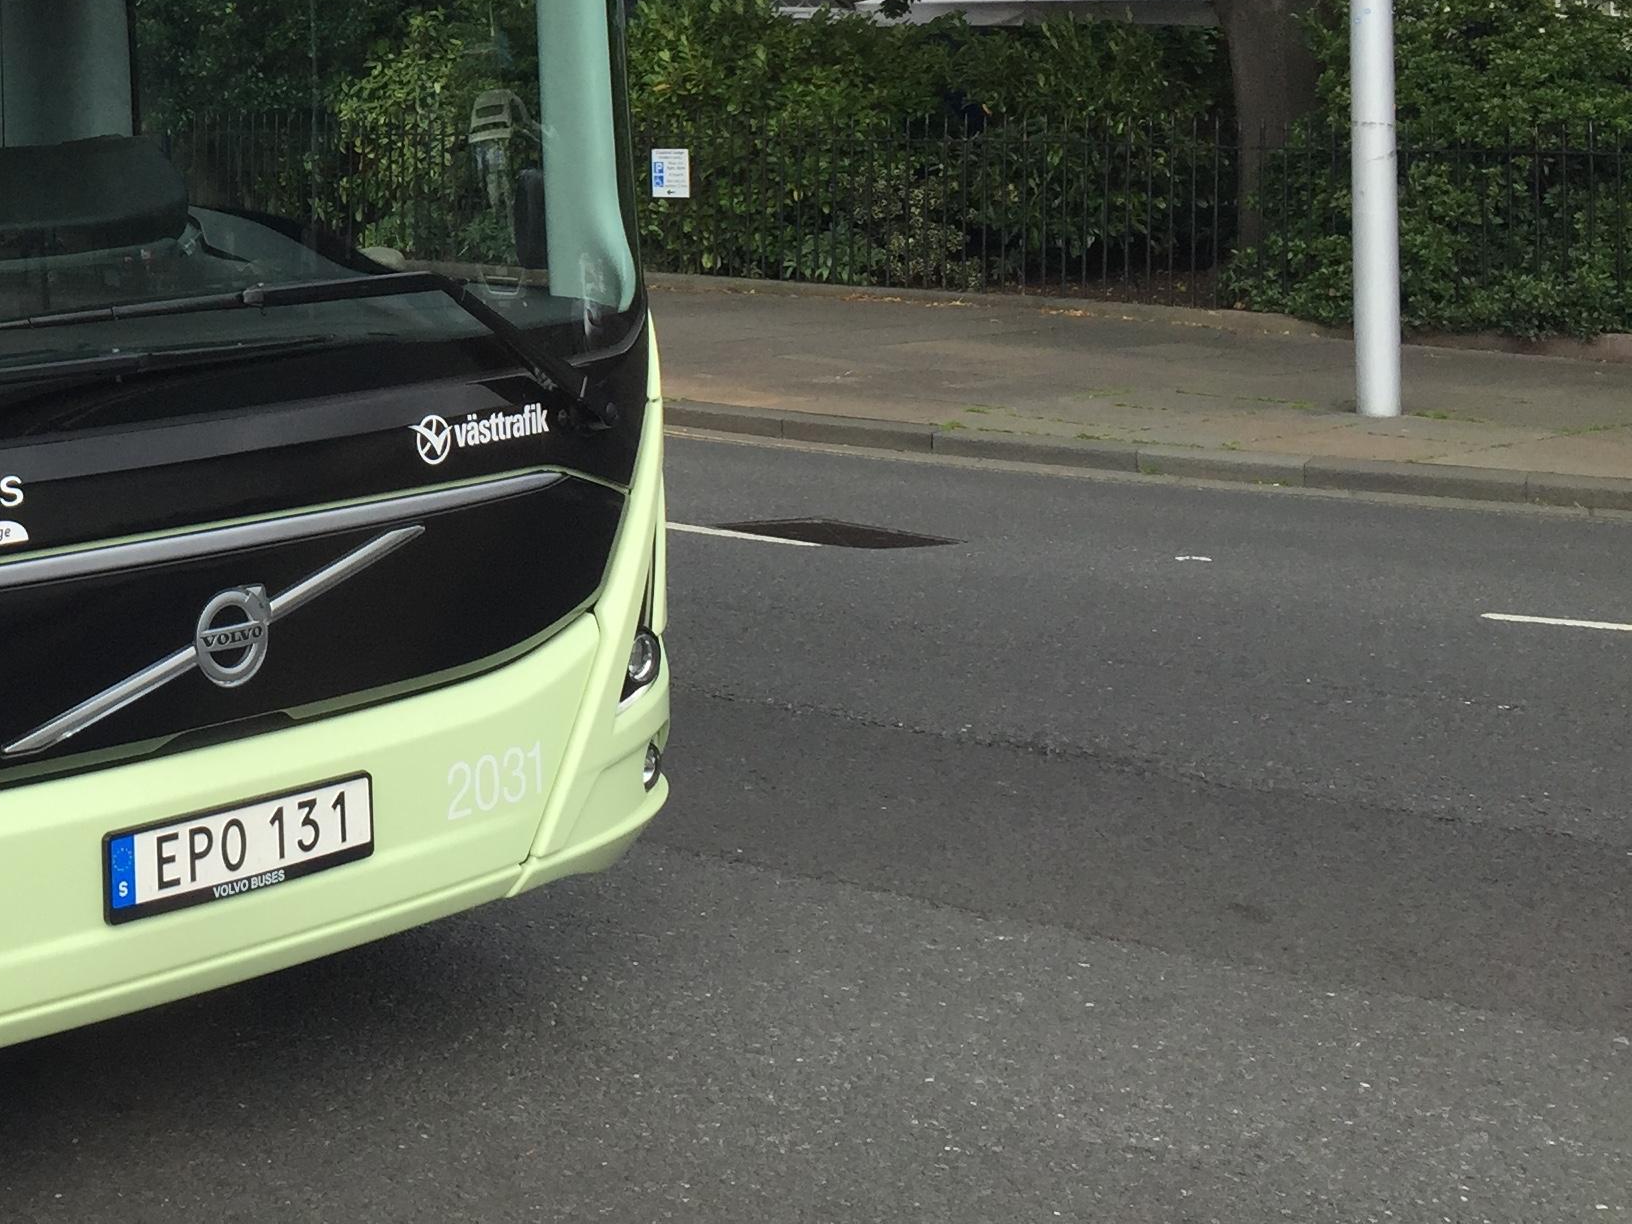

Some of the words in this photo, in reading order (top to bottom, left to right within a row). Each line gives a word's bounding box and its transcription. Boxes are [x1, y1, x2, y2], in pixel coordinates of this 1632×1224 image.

[454, 402, 549, 447] västtrafik
[200, 626, 262, 648] VOLVO
[448, 740, 542, 820] 2031
[156, 818, 247, 890] EPO
[269, 790, 347, 859] 131
[118, 881, 128, 897] S
[212, 879, 249, 898] VOLVO
[250, 869, 285, 889] BUSES
